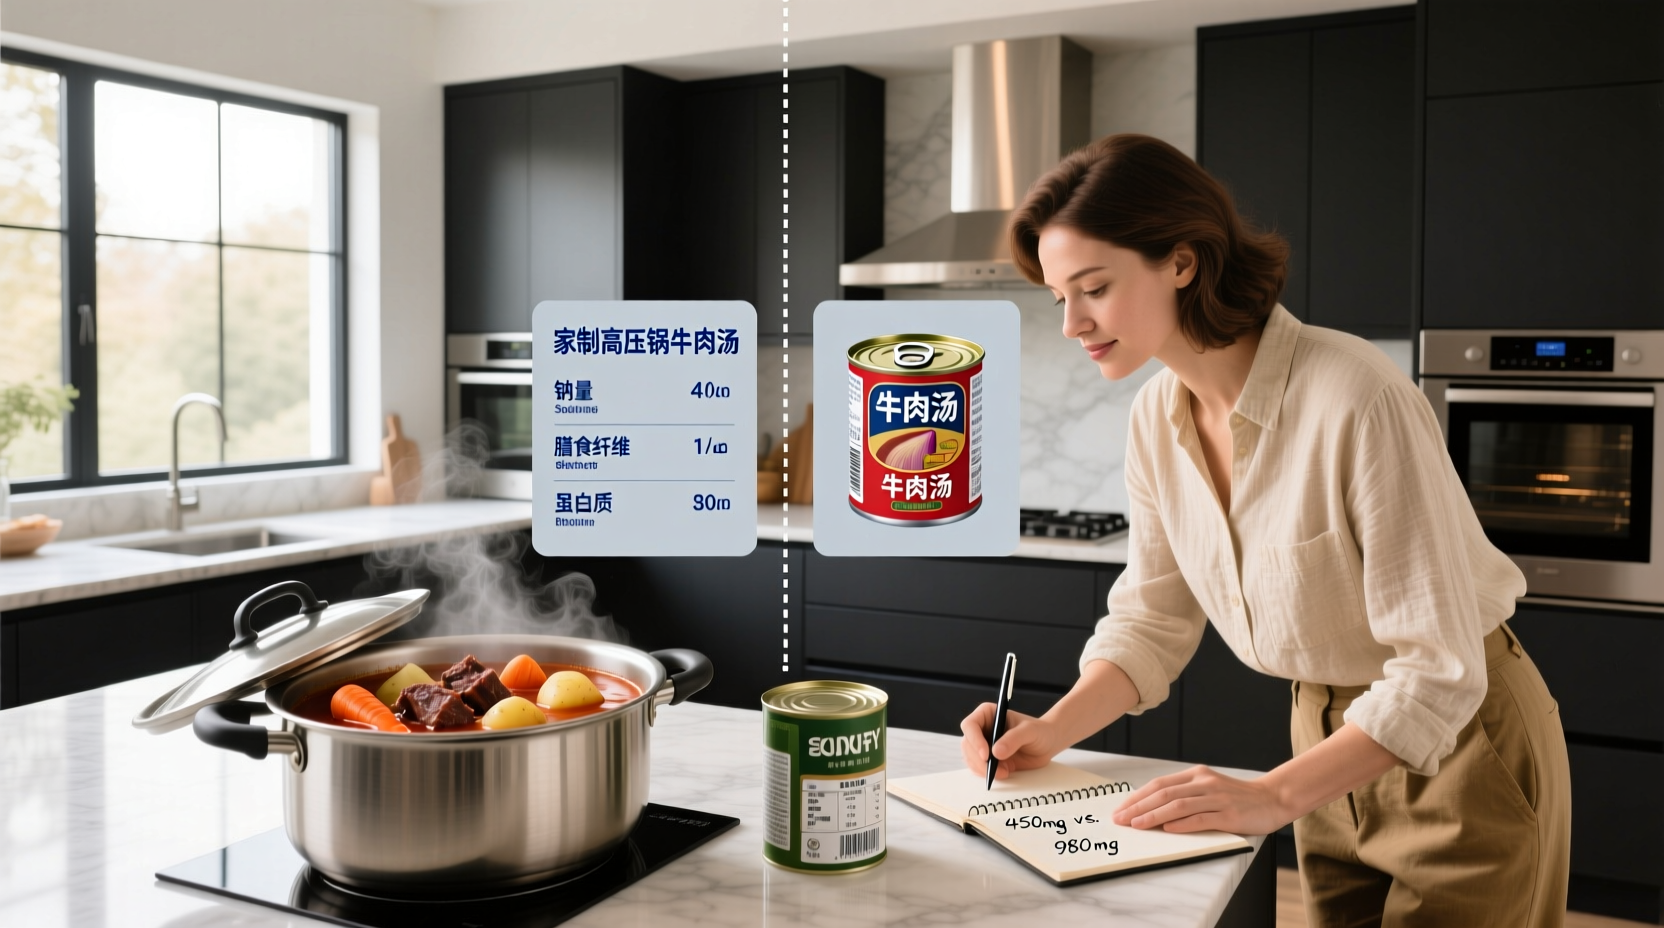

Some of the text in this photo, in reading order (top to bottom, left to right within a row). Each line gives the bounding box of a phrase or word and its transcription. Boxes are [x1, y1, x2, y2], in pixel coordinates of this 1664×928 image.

[876, 390, 958, 423] 牛肉汤
[881, 473, 952, 500] 牛肉汤
[1005, 814, 1099, 834] 450mg vs.
[1055, 838, 1118, 855] 980mg
